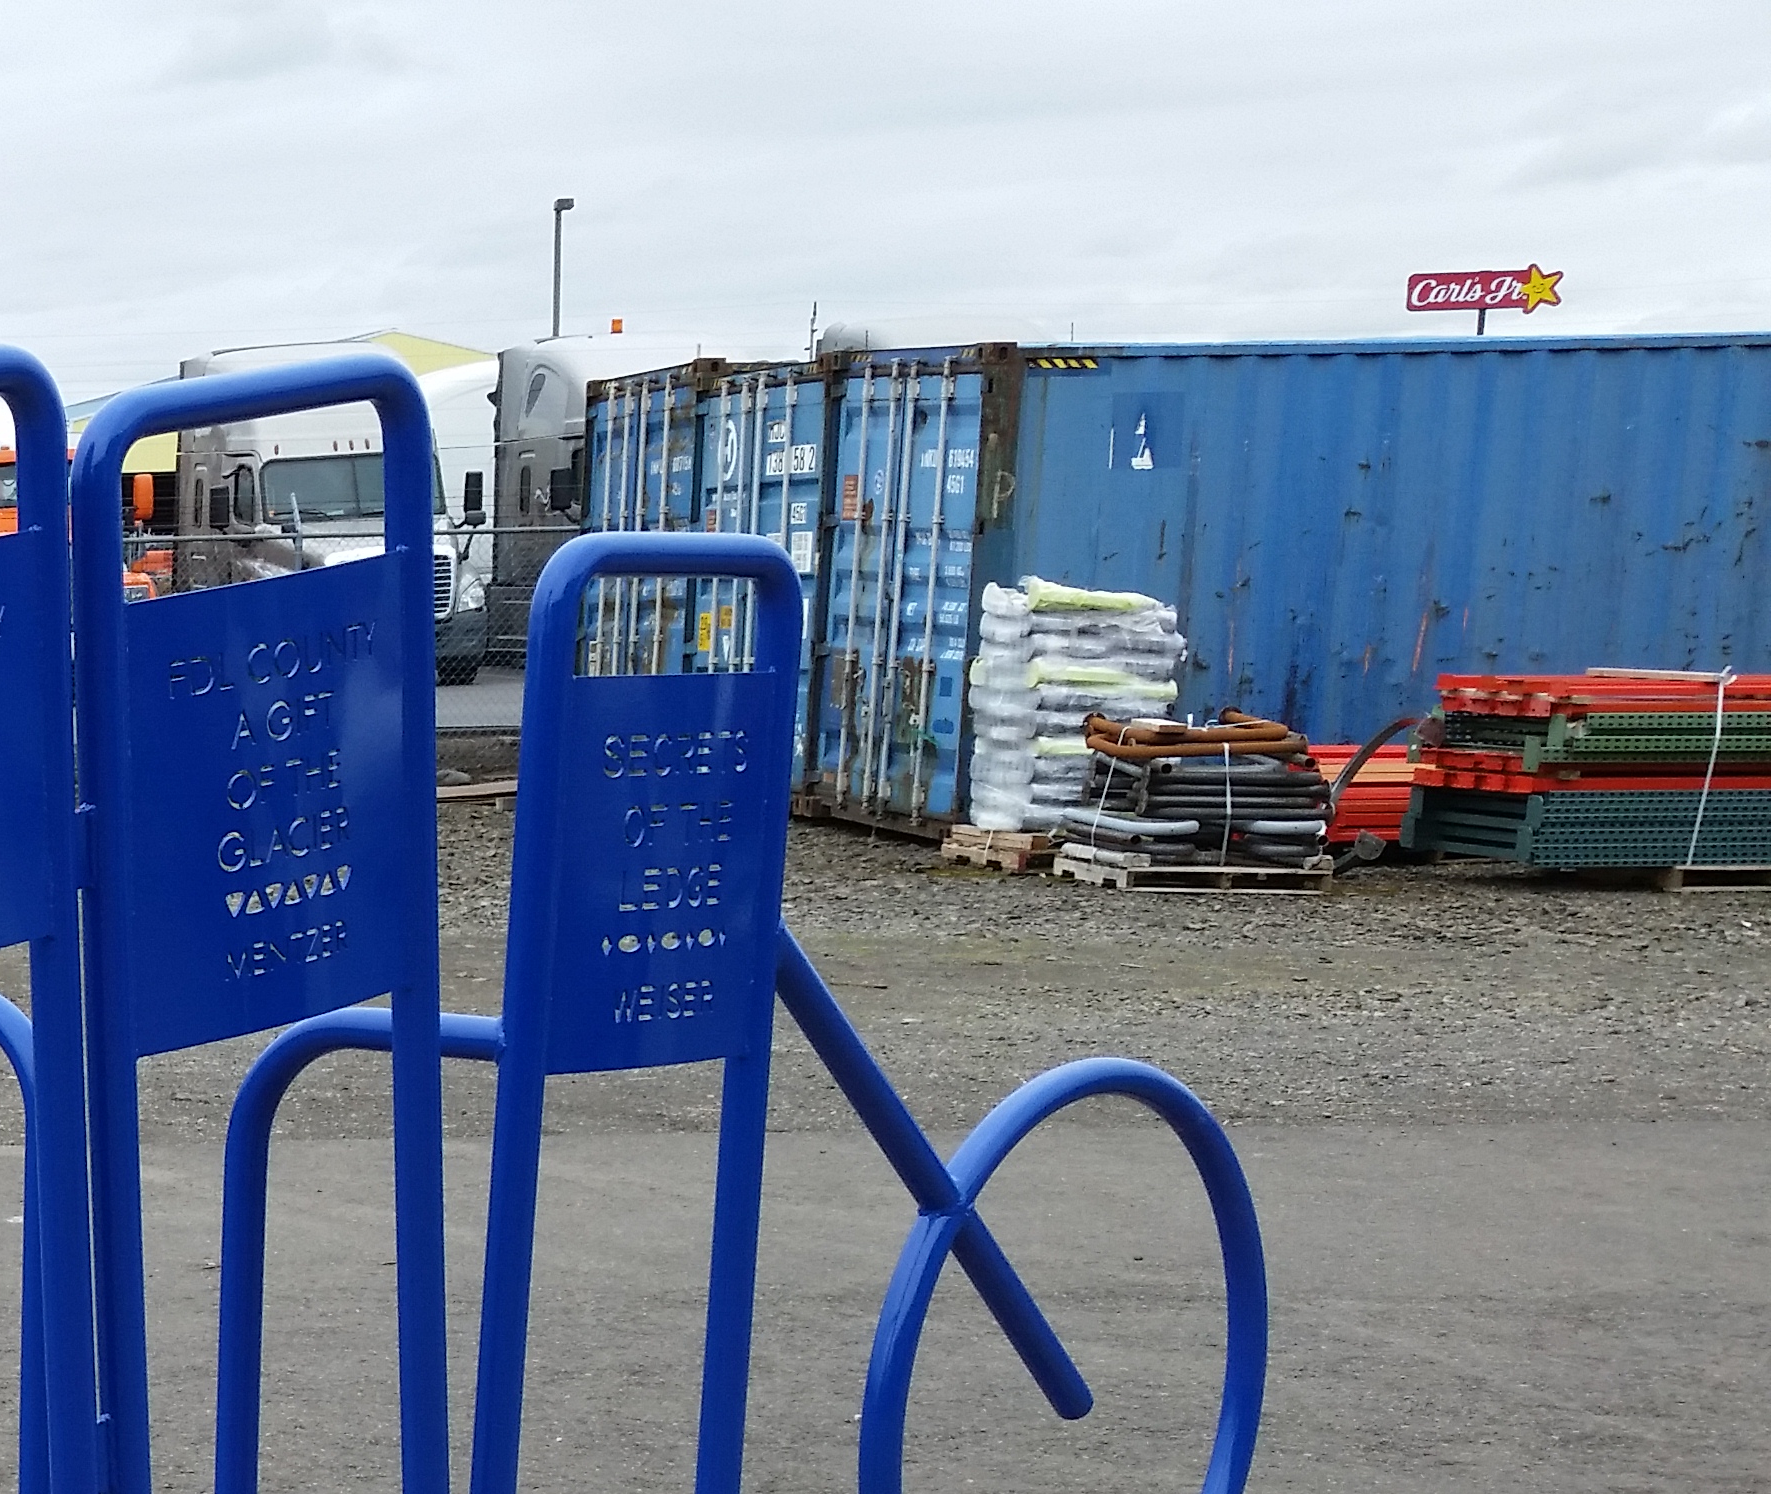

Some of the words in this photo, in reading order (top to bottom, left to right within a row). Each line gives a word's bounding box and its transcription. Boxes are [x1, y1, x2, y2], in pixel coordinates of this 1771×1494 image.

[1411, 276, 1485, 307] Carl's
[1485, 276, 1529, 305] Jr.
[168, 651, 235, 701] FDL
[247, 621, 377, 685] COUNTY
[230, 712, 257, 751] A
[265, 690, 335, 742] GIFT
[602, 729, 749, 779] SECRETS
[226, 764, 275, 811] OF
[285, 748, 342, 798] THE
[217, 806, 351, 873] GLACIER
[622, 803, 668, 849] OF
[679, 801, 734, 848] THE
[618, 863, 722, 912] LEDGE
[613, 980, 714, 1025] WEISER
